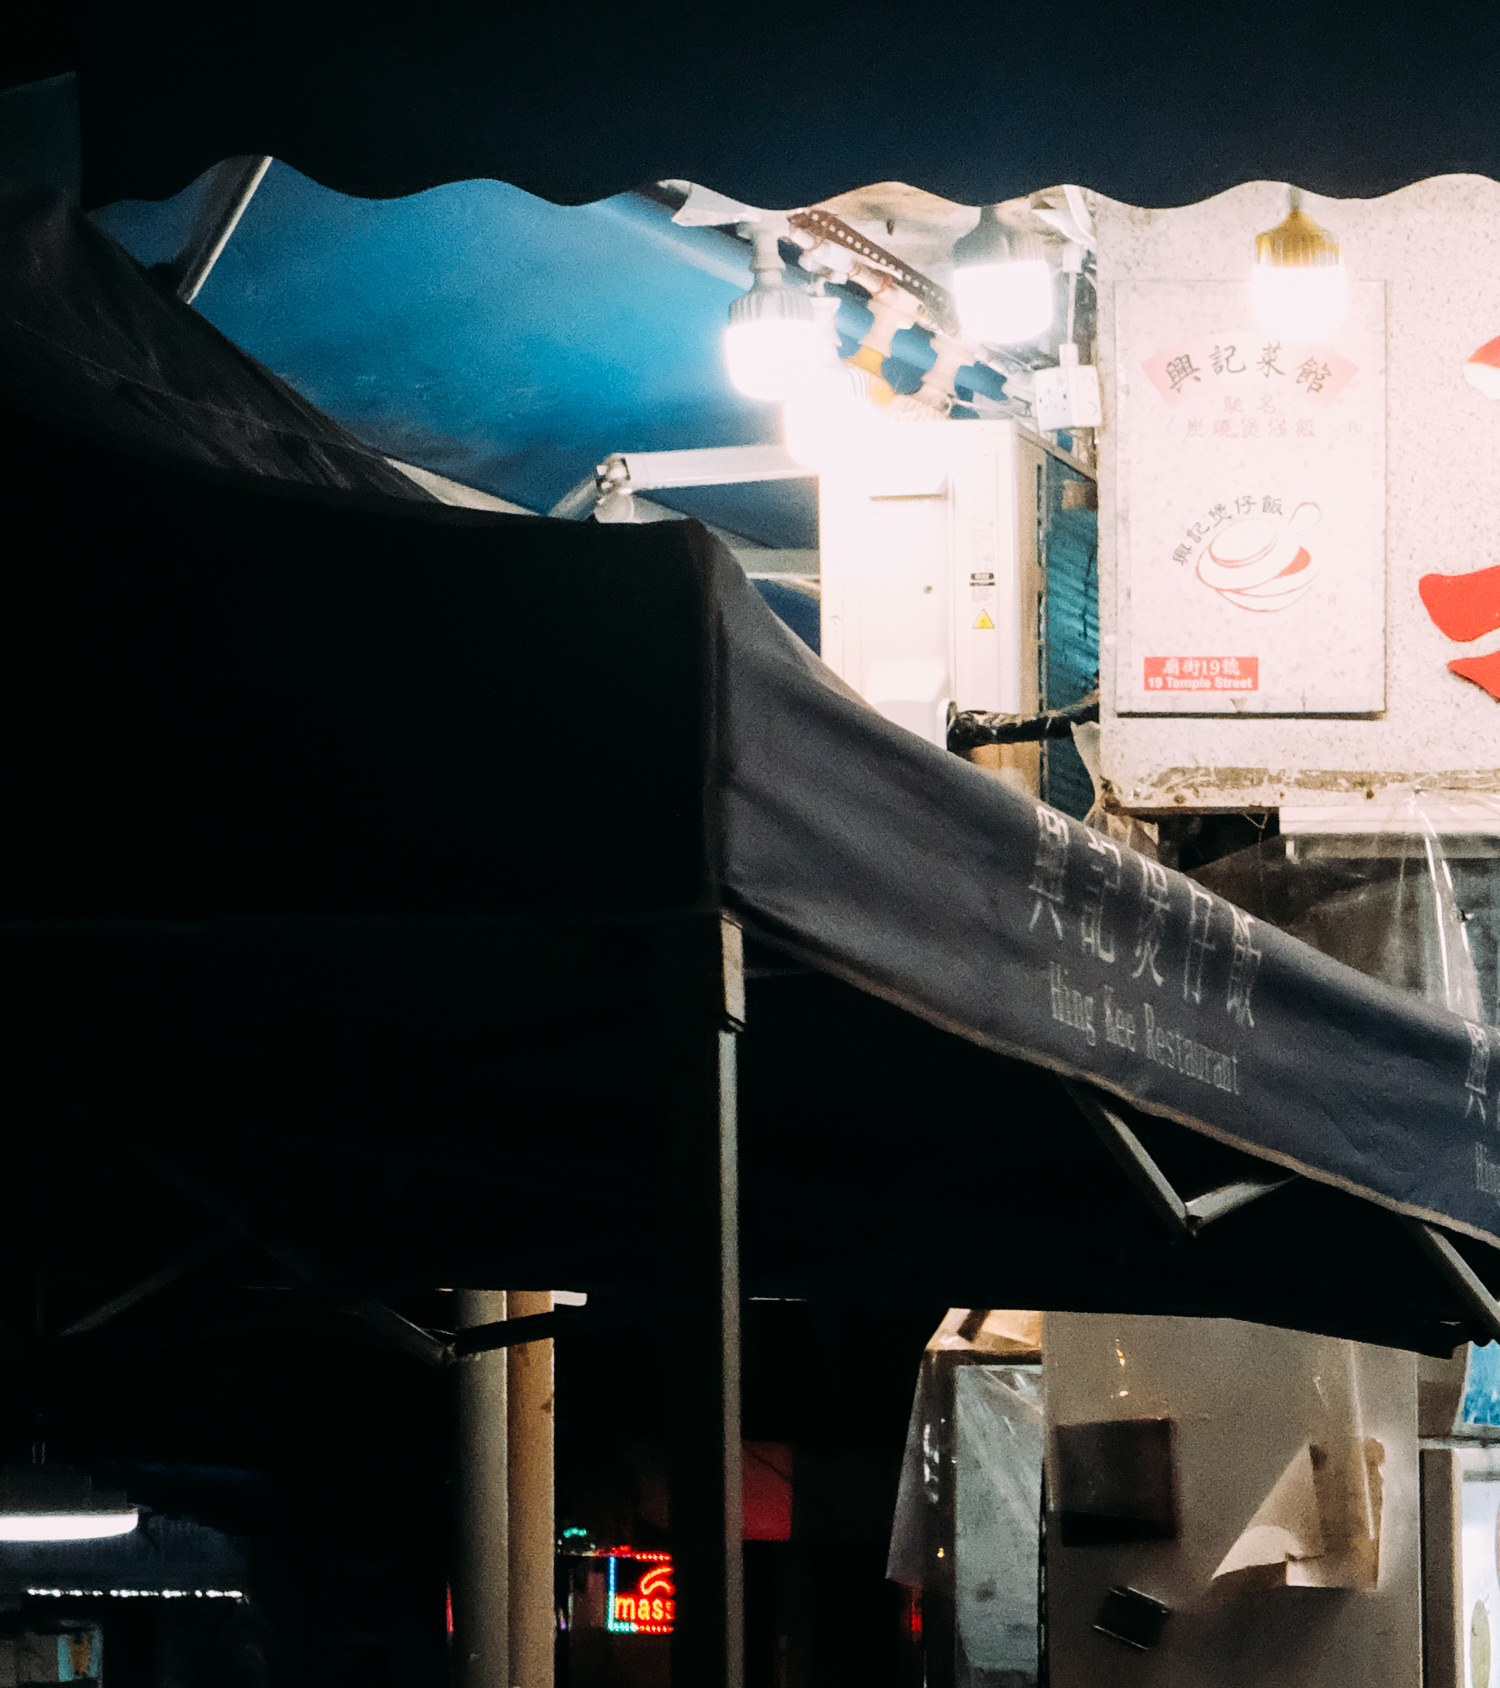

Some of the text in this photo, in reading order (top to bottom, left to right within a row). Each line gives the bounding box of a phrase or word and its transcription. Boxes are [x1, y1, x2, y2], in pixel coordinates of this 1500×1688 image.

[1164, 341, 1333, 395] 興記菜館
[1148, 677, 1253, 691] 19 Temple Street
